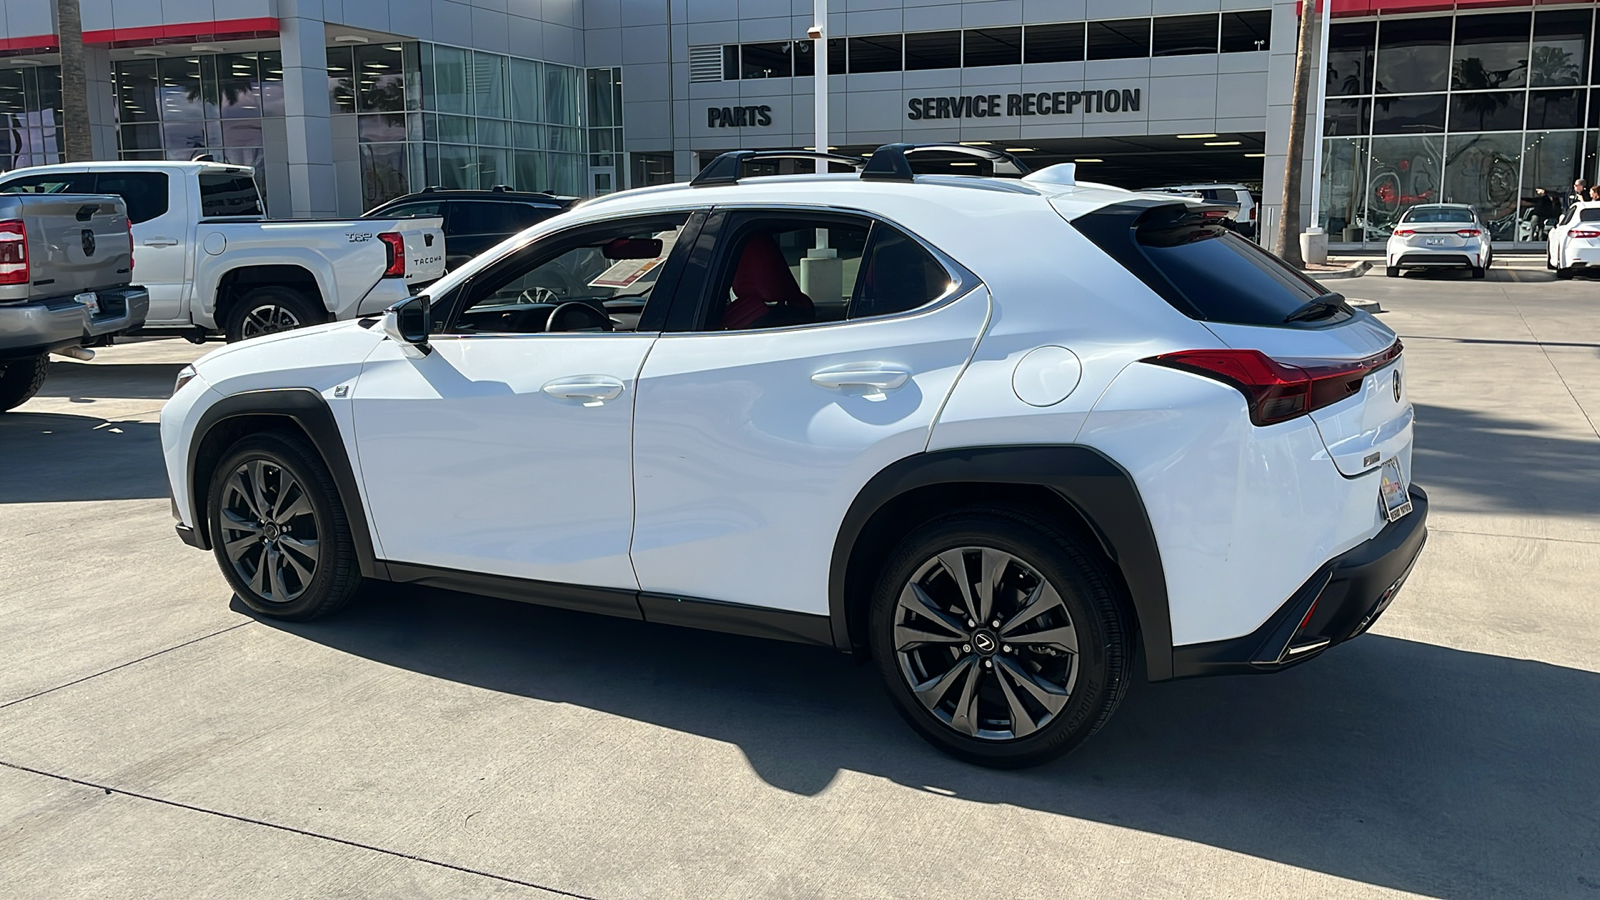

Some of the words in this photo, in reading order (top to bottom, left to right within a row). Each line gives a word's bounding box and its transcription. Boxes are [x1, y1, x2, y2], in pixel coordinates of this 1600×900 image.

[908, 95, 1001, 120] SERVICE
[1007, 88, 1141, 117] RECEPTION
[707, 105, 772, 128] PARTS
[345, 232, 373, 240] TRD
[413, 255, 442, 266] TACOMA
[1047, 678, 1100, 749] BRIDGESTONE
